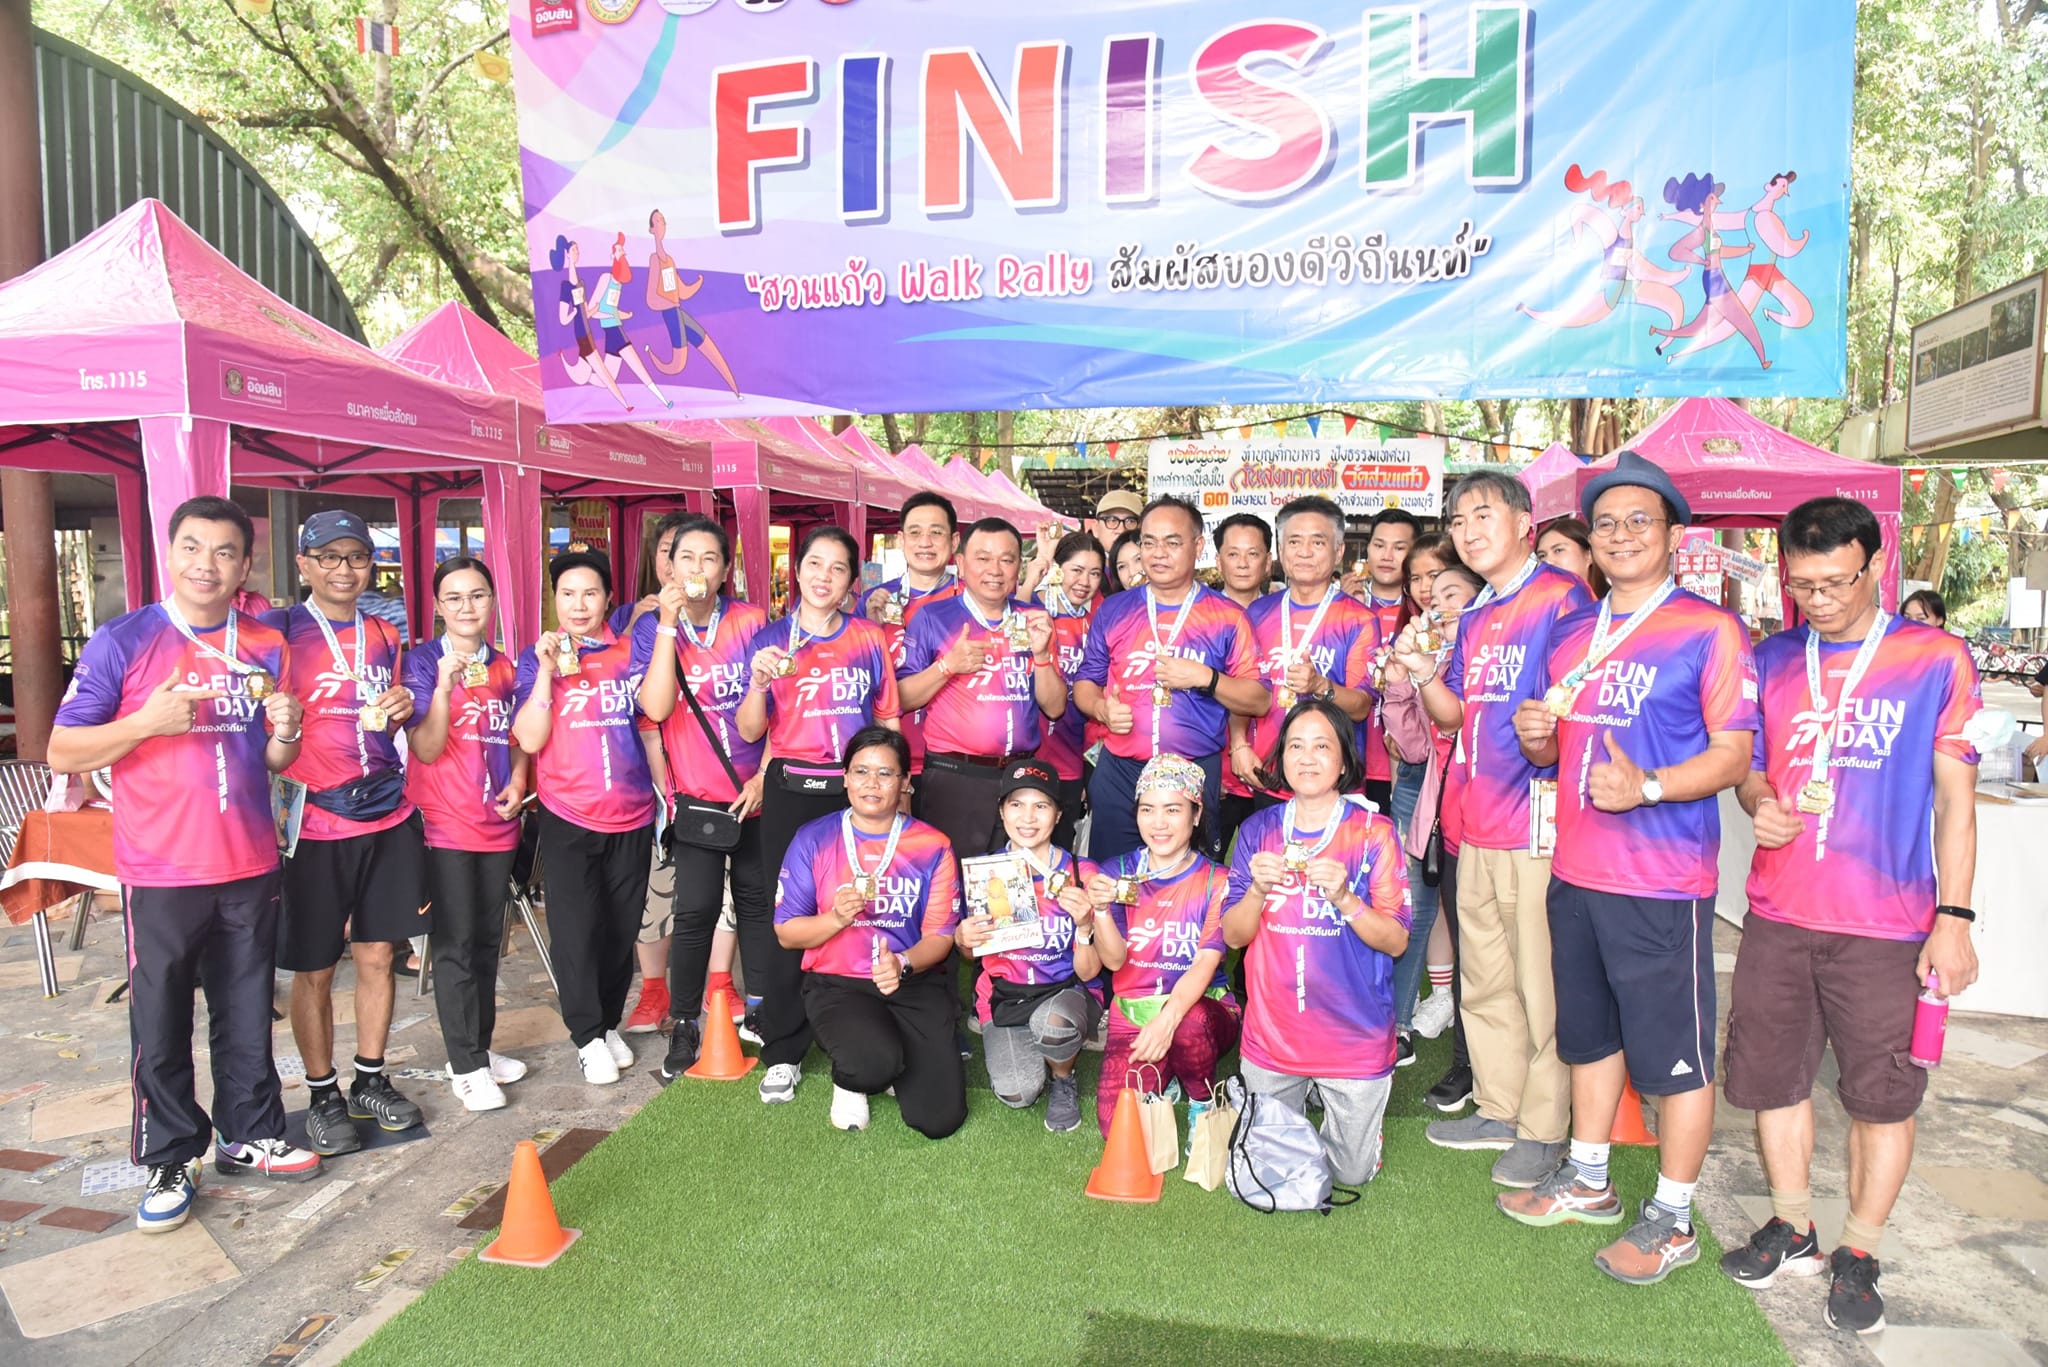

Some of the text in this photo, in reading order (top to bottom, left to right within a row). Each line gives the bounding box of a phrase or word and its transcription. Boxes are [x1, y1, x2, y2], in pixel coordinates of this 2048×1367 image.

[535, 8, 573, 23] ออมสิน
[713, 4, 1529, 230] FINISH
[900, 257, 981, 301] Walk
[999, 252, 1090, 294] Rally
[1109, 222, 1489, 289] สัมผัสของดีวิถีนนท์"
[78, 369, 148, 390] โทร.1115
[247, 380, 282, 398] ออมสิน
[346, 402, 417, 426] ธนาคารเพื่อสังคม
[470, 419, 503, 441] โทร.1115
[713, 463, 737, 474] .1115
[1343, 465, 1424, 489] วัดสวนแก้ว
[1700, 486, 1772, 500] ธนาคารเพื่อสังคม
[1836, 487, 1879, 500] โทร.1115
[1308, 643, 1336, 665] UN
[830, 667, 871, 685] FUN
[1485, 665, 1523, 686] DAY
[1603, 660, 1658, 687] FUN
[211, 674, 250, 696] FU
[832, 683, 870, 705] DAY
[214, 698, 259, 718] DAY
[1597, 685, 1651, 710] DAY
[1624, 708, 1640, 716] 2023
[1837, 697, 1906, 725] FUN
[1836, 725, 1902, 751] DAY
[1872, 748, 1892, 757] 2023
[875, 877, 921, 896] FUN
[874, 897, 918, 914] DAY
[1039, 916, 1073, 933] UN
[1164, 920, 1201, 940] FUN
